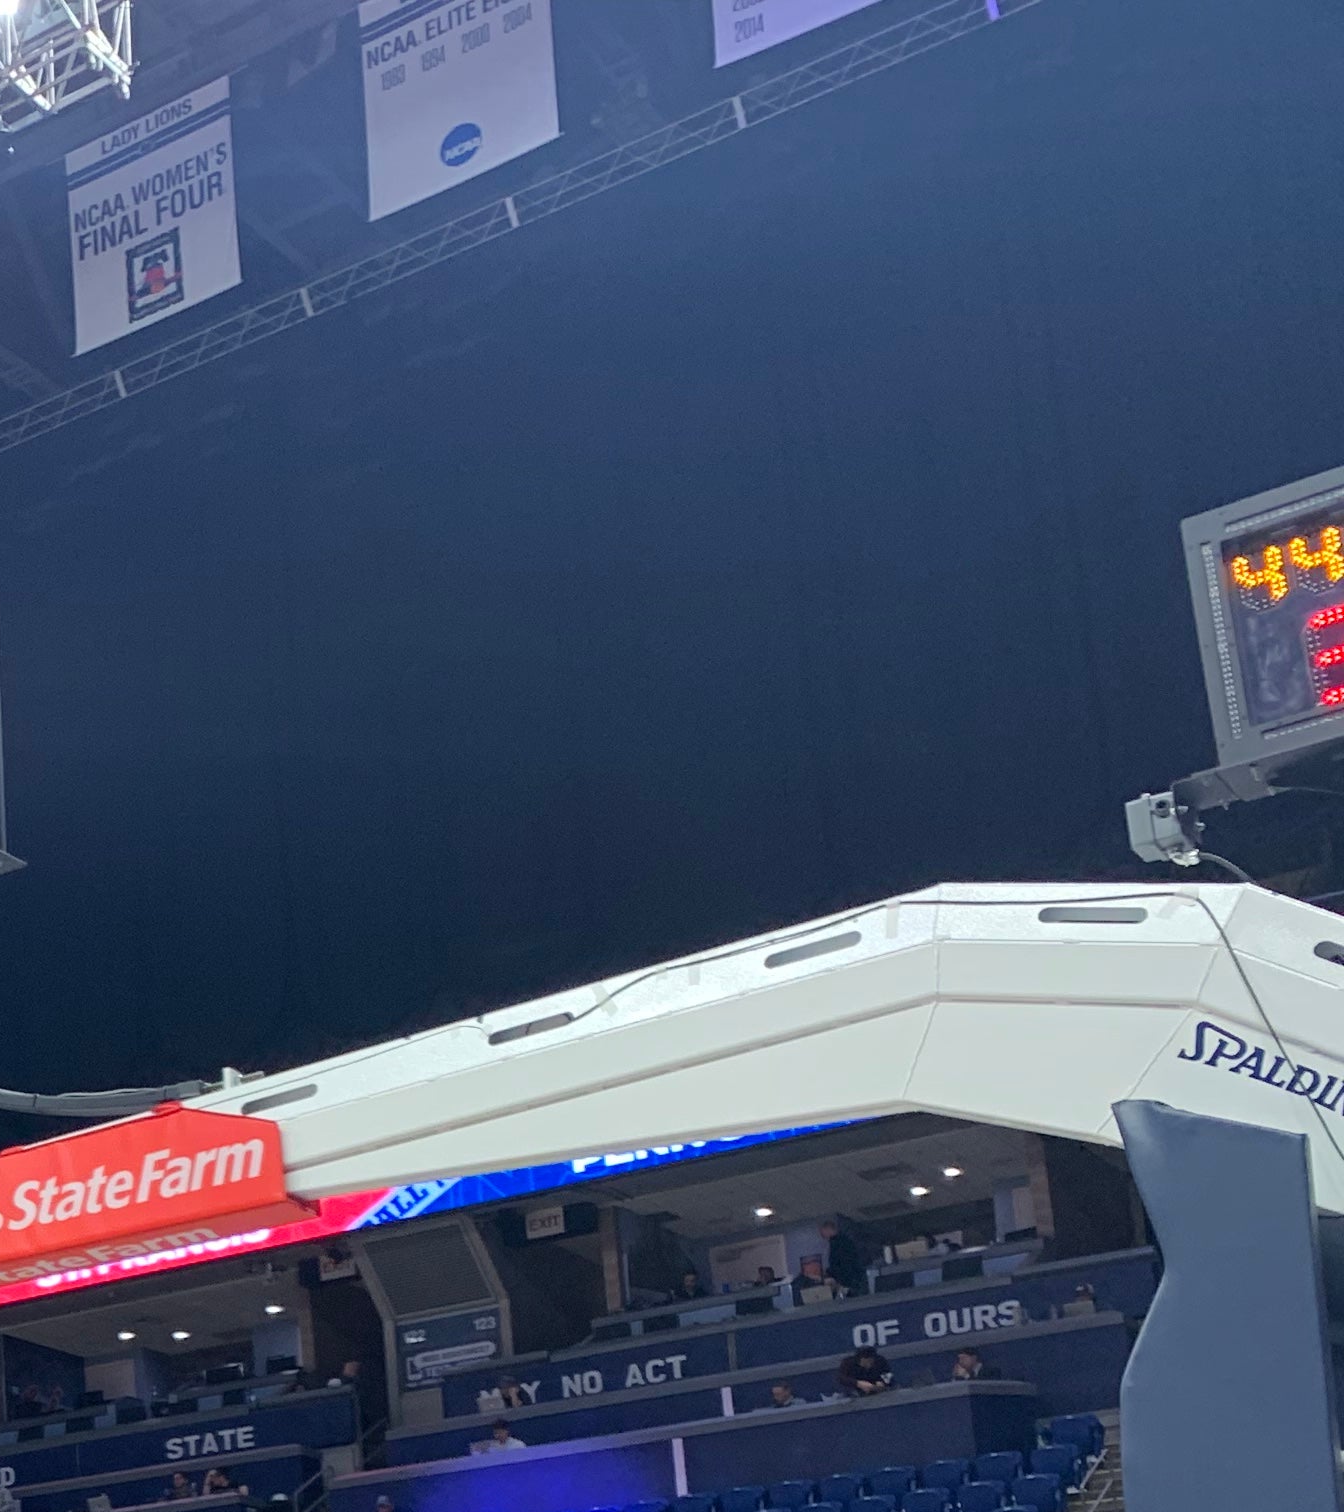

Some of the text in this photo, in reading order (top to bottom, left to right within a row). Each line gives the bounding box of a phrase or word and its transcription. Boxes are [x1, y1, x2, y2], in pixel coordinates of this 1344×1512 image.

[367, 1, 478, 69] NCAA ELITE
[734, 14, 764, 43] 2014
[101, 98, 193, 155] LADY LIONS
[74, 142, 227, 233] NCAA WOMEN'S
[78, 171, 224, 261] FINAL FOUR
[1177, 1021, 1344, 1117] SPALDI
[529, 1214, 561, 1233] EXIT
[473, 1316, 496, 1331] 123
[562, 1370, 604, 1398] NO
[625, 1355, 687, 1387] ACT
[853, 1319, 901, 1348] OF
[924, 1299, 1021, 1339] OURS
[166, 1426, 256, 1462] STATE
